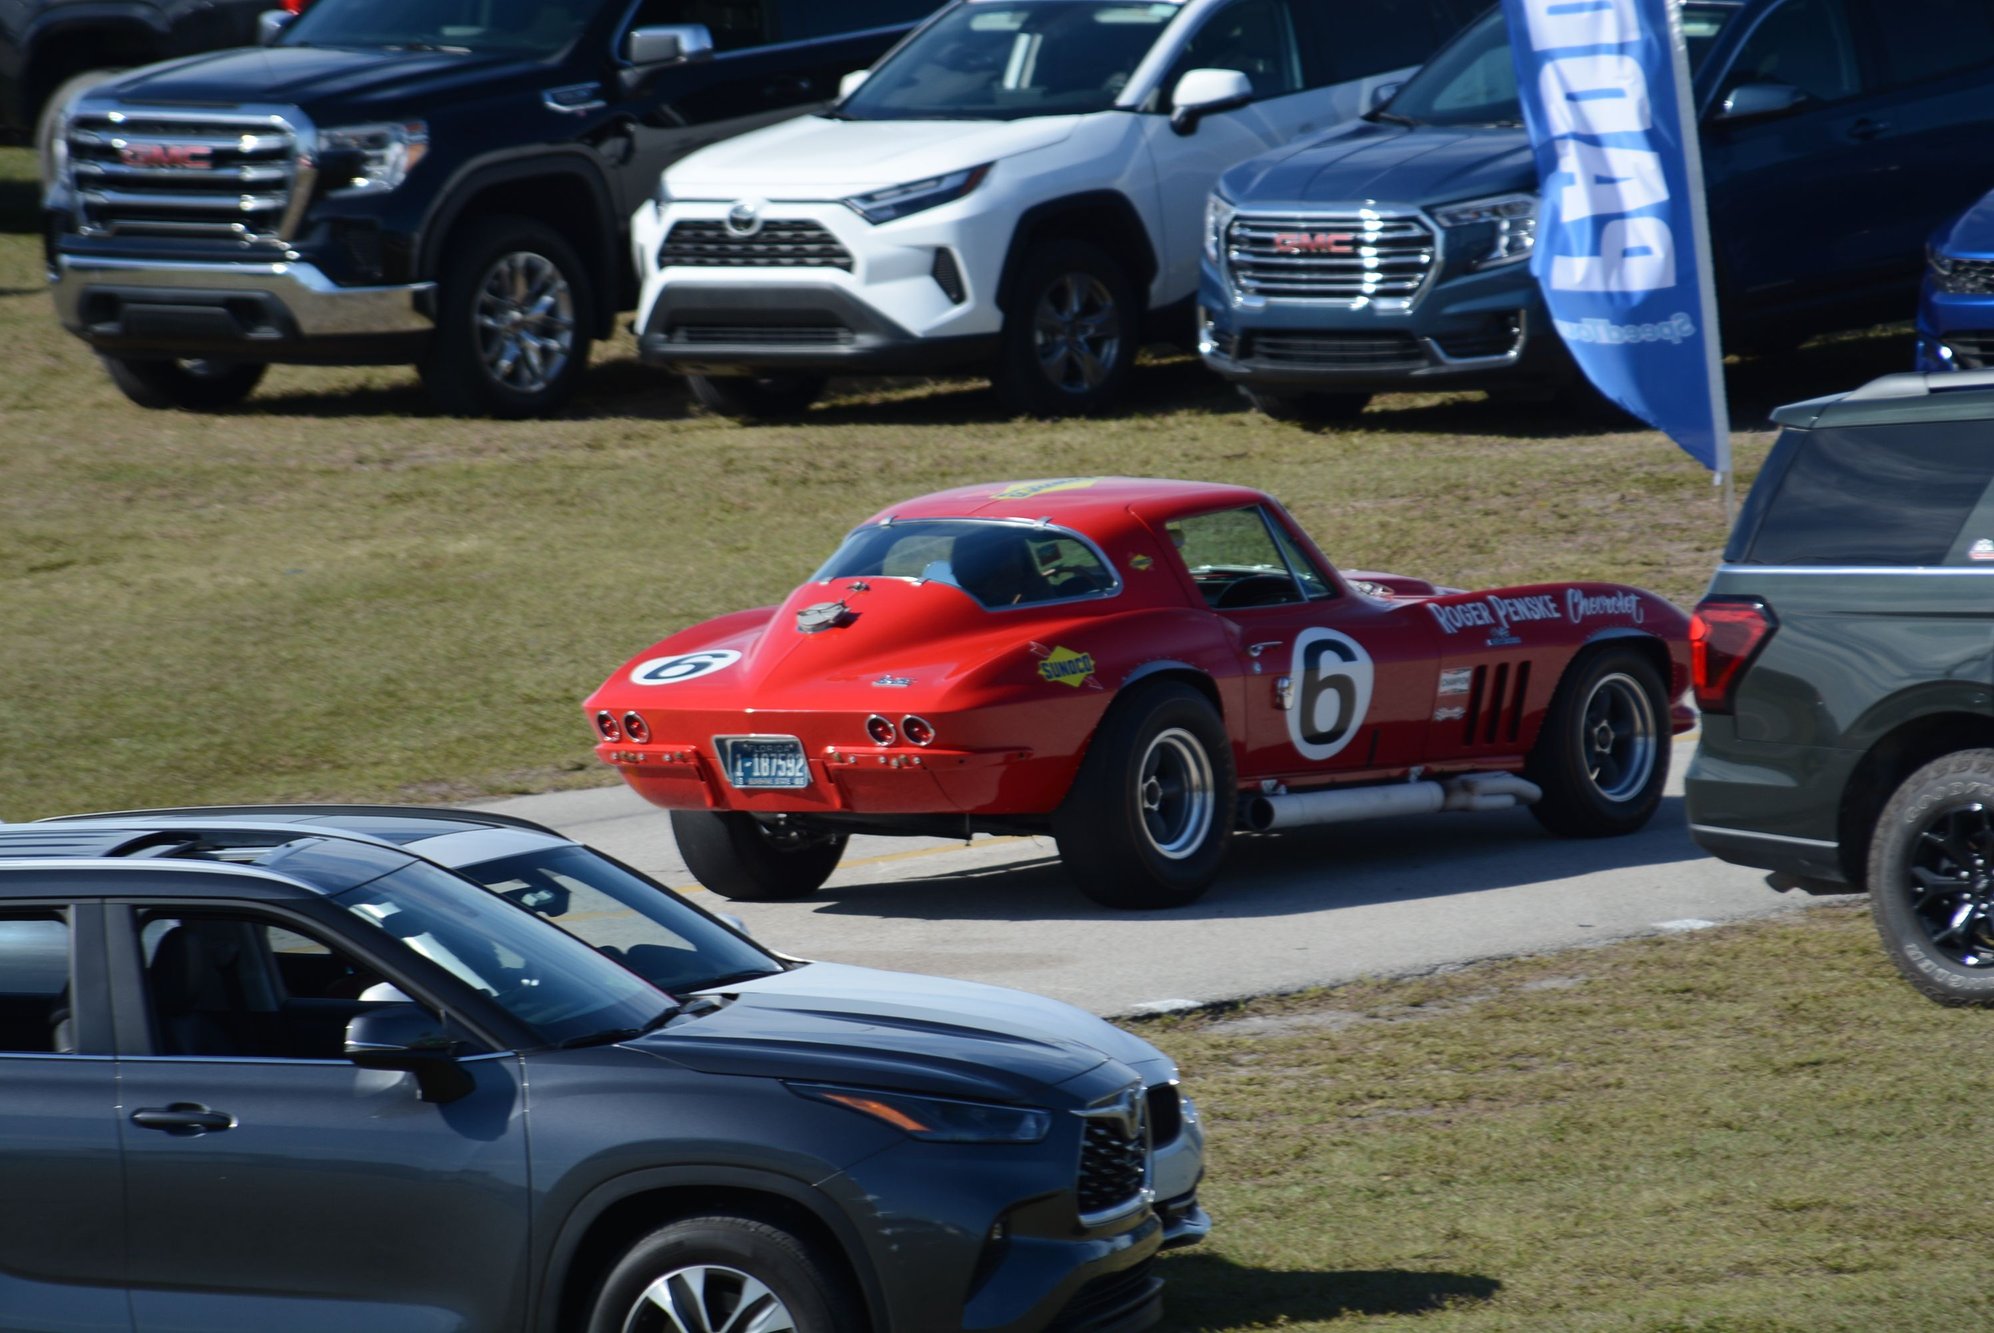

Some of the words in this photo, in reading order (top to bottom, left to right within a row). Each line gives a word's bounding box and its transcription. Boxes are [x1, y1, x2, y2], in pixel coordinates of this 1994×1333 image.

[122, 144, 211, 168] GMC
[1274, 232, 1352, 253] GMC
[1426, 602, 1495, 634] ROGER
[1487, 595, 1561, 629] PENSKE
[1566, 588, 1644, 624] Chevrolet
[643, 653, 730, 680] 6
[1040, 654, 1093, 680] SUNOCO
[1299, 638, 1359, 746] 6
[735, 753, 805, 777] 1-187592
